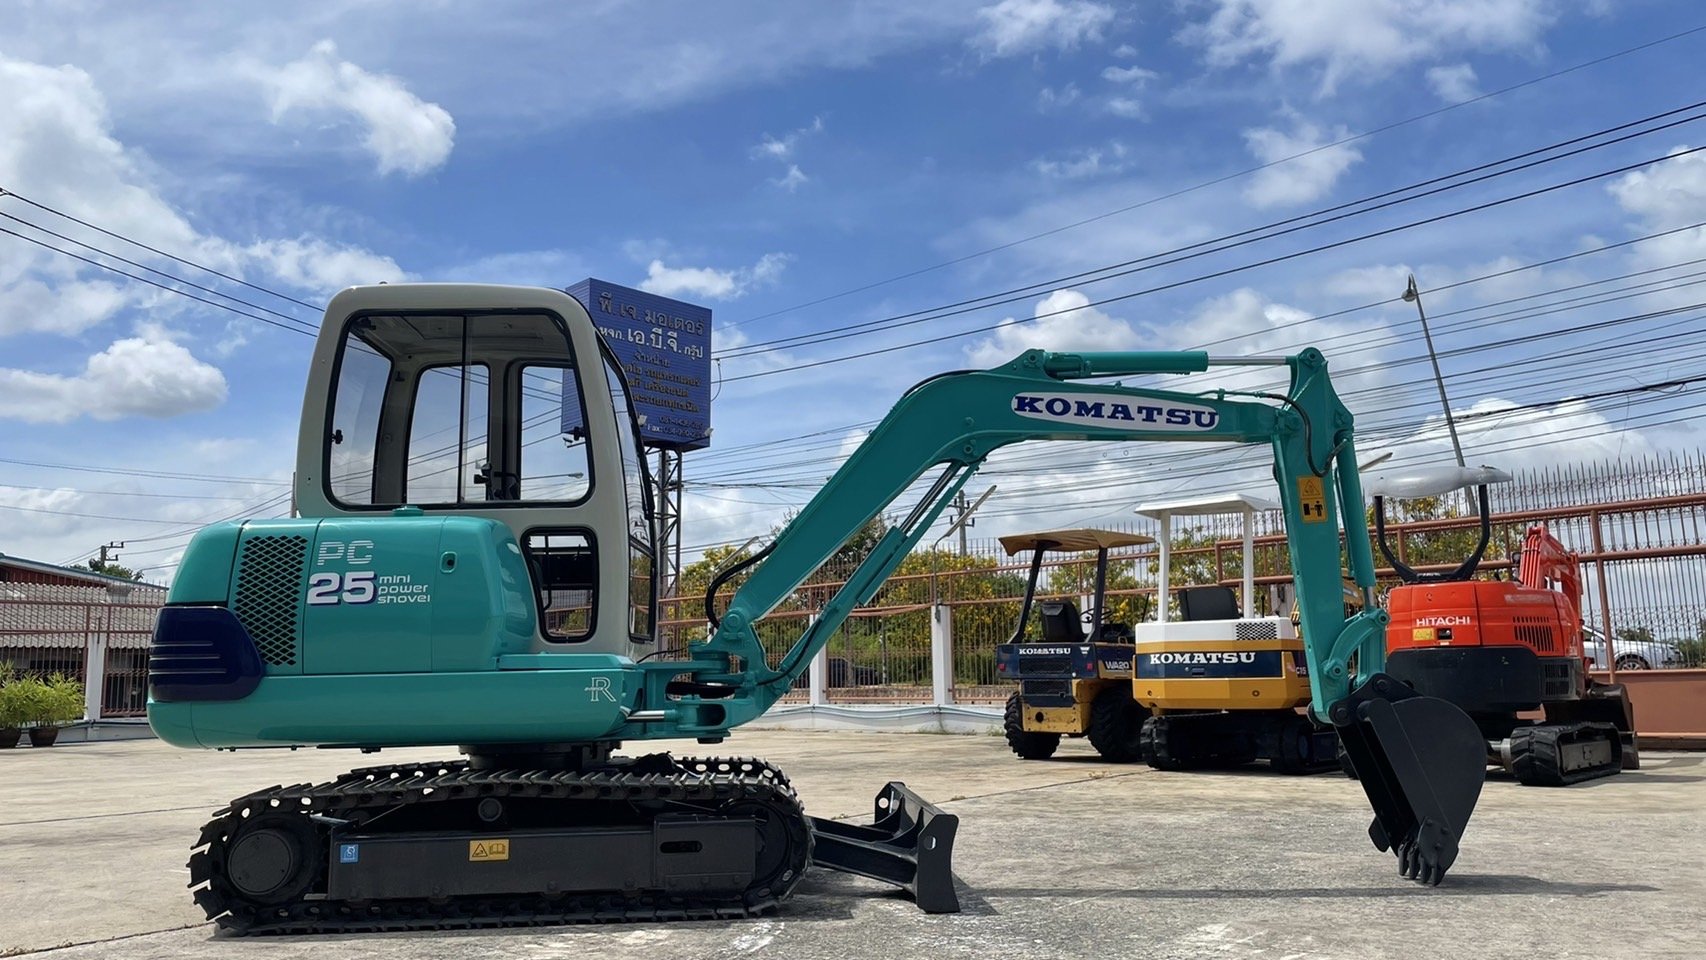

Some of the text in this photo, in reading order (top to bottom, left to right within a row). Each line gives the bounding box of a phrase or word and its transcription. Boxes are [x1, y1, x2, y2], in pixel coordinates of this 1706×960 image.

[1014, 396, 1218, 428] KOMATSU
[317, 540, 374, 566] PC
[379, 574, 411, 584] mini
[307, 571, 377, 605] 25
[378, 584, 429, 595] power
[377, 594, 431, 604] shovel
[1416, 616, 1471, 627] HITACHI
[1019, 647, 1071, 655] KOMATSU
[1150, 652, 1256, 665] KOMATSU
